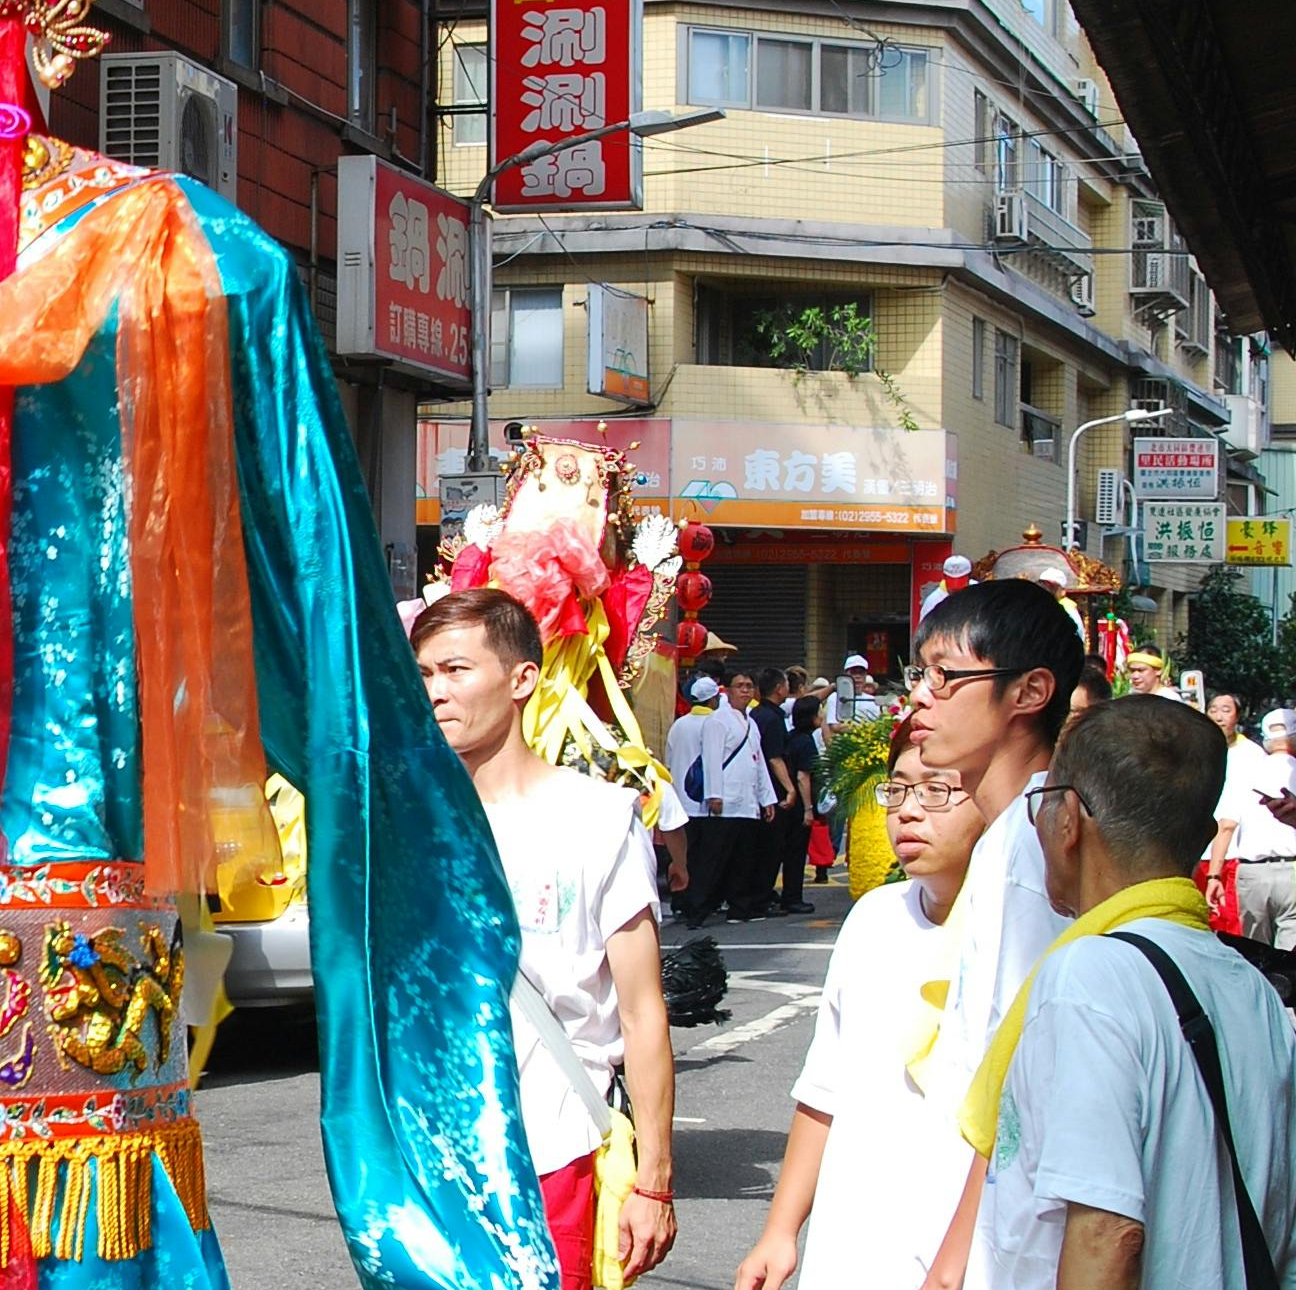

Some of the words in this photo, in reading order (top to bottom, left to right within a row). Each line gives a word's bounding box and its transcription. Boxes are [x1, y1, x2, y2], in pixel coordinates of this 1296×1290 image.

[519, 6, 606, 199] 涮涮鍋
[743, 448, 858, 494] 東方美
